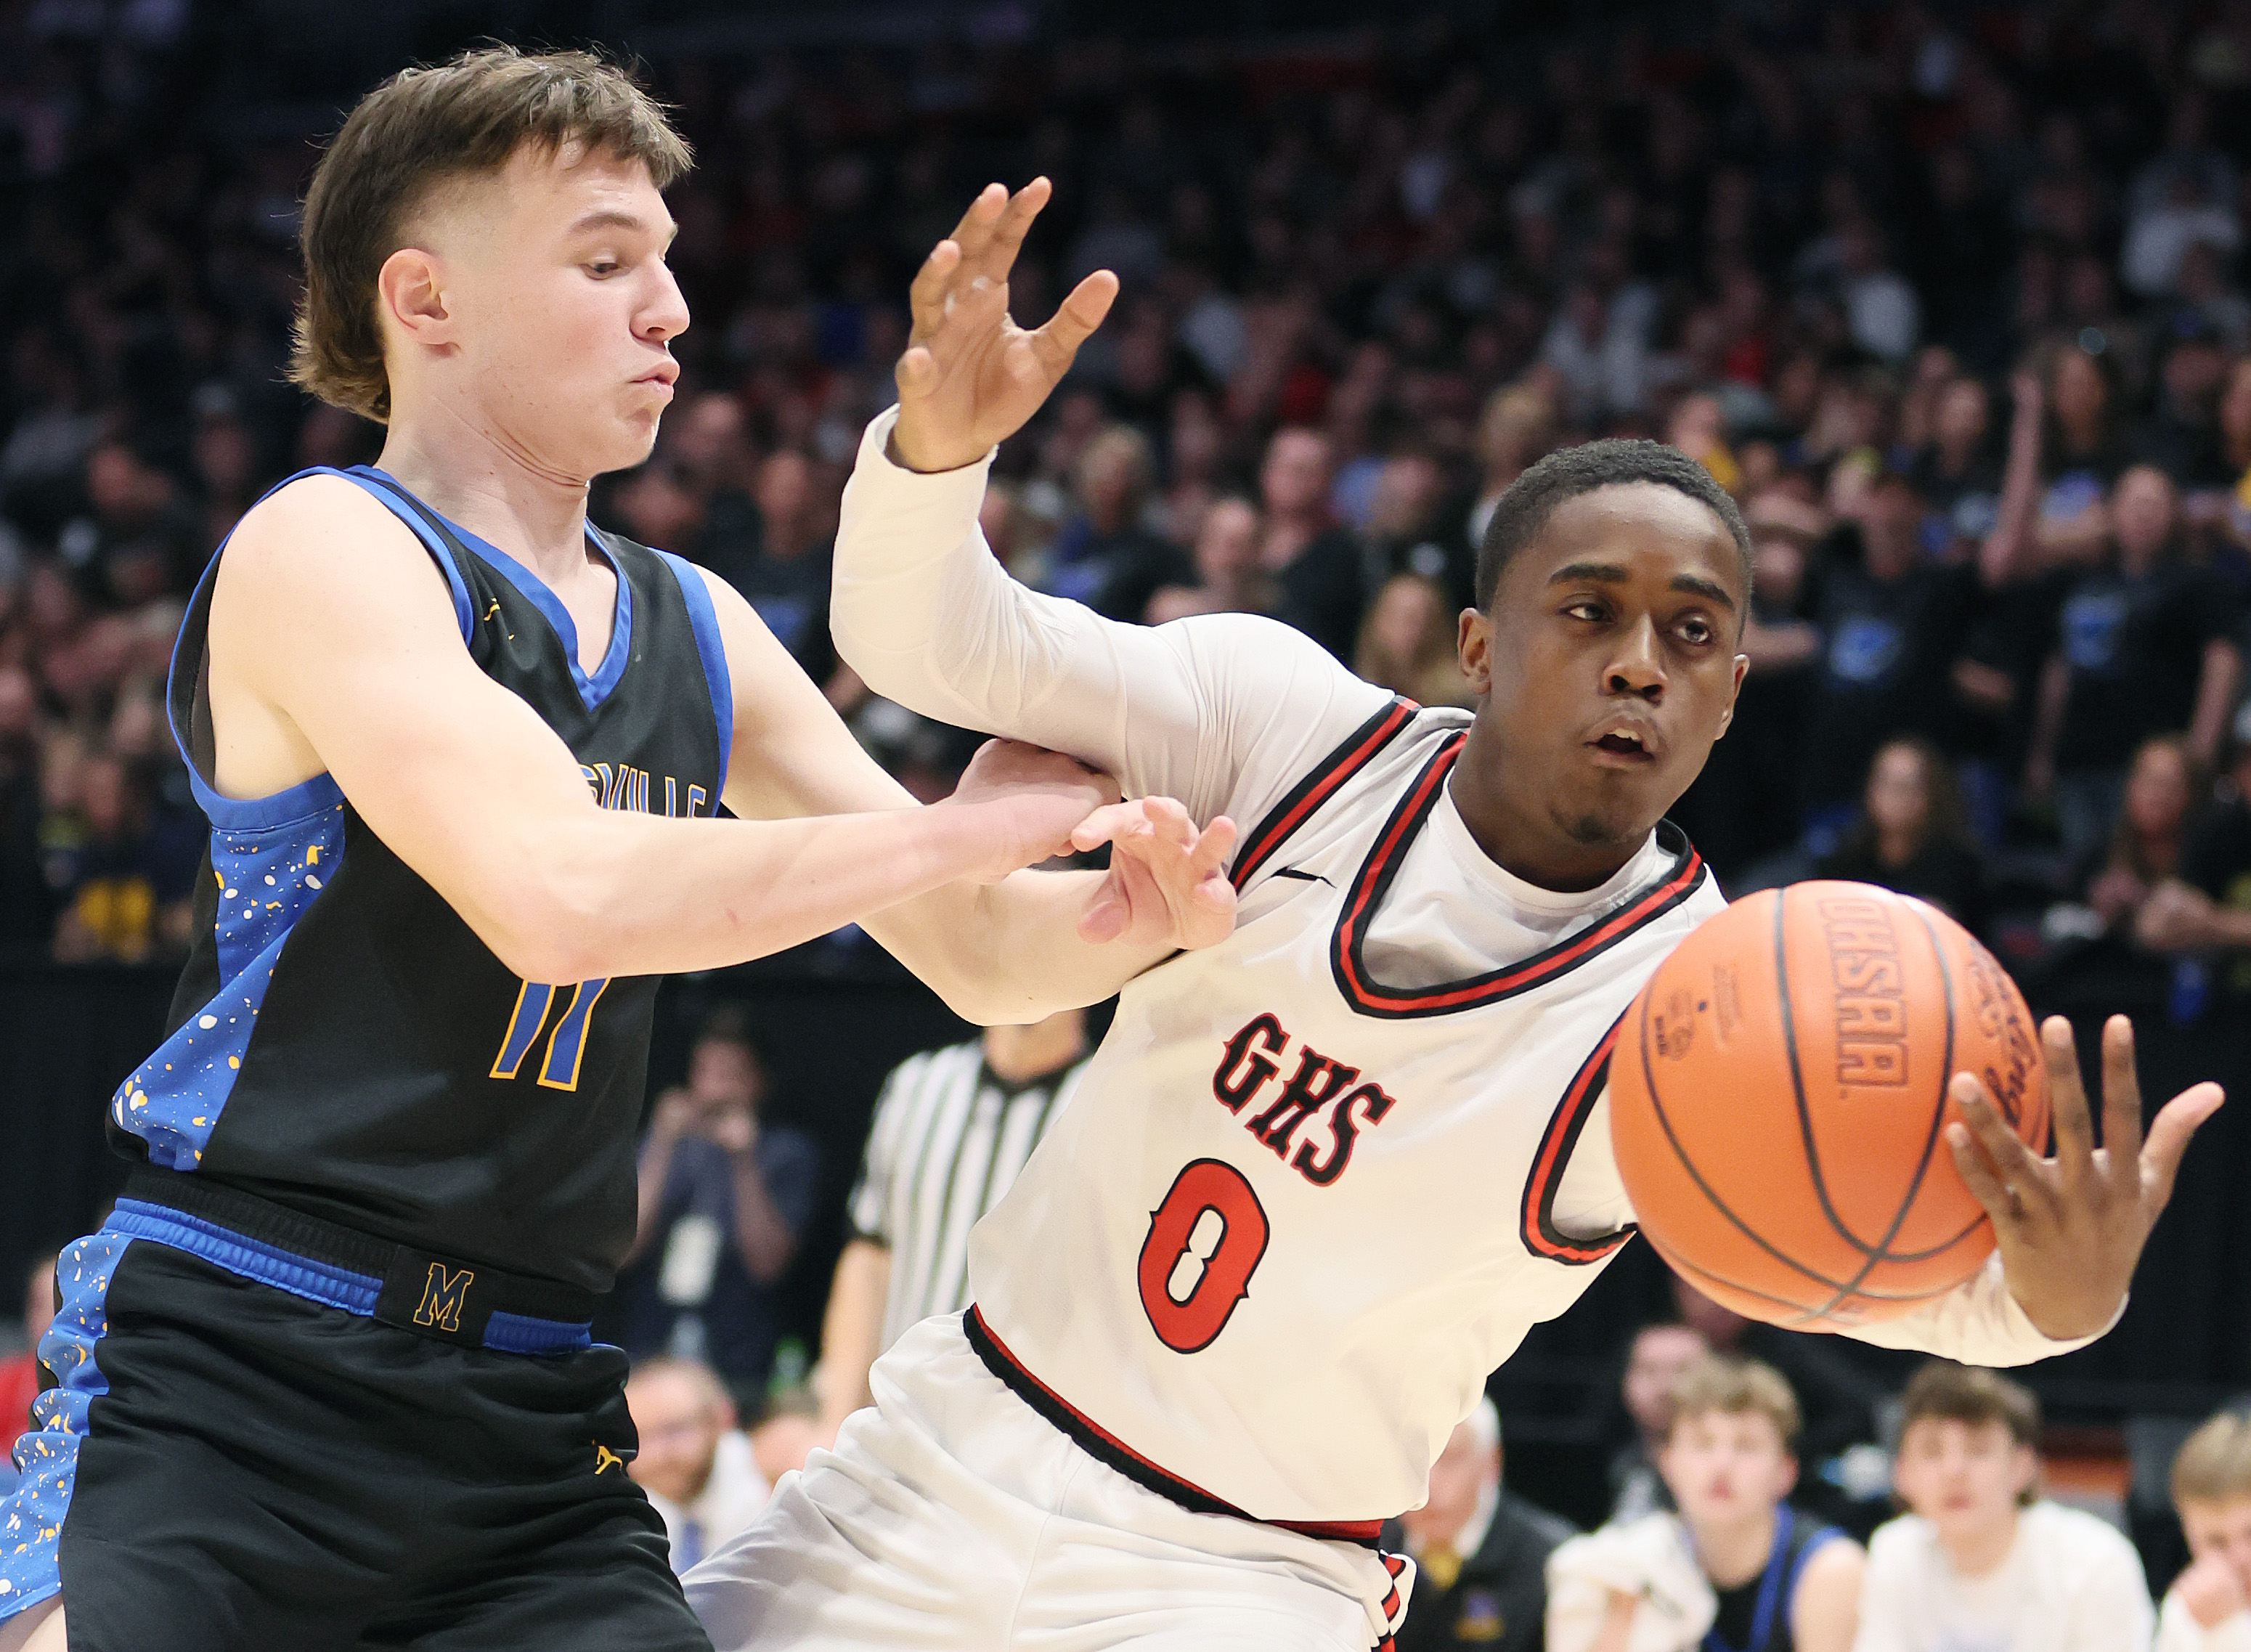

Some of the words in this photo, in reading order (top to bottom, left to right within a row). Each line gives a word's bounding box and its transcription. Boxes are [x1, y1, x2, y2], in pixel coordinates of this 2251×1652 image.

[1818, 898, 1909, 1088] OHSAA
[1213, 1012, 1397, 1187] GHS
[413, 1262, 474, 1332] M
[1137, 1157, 1270, 1354] 0
